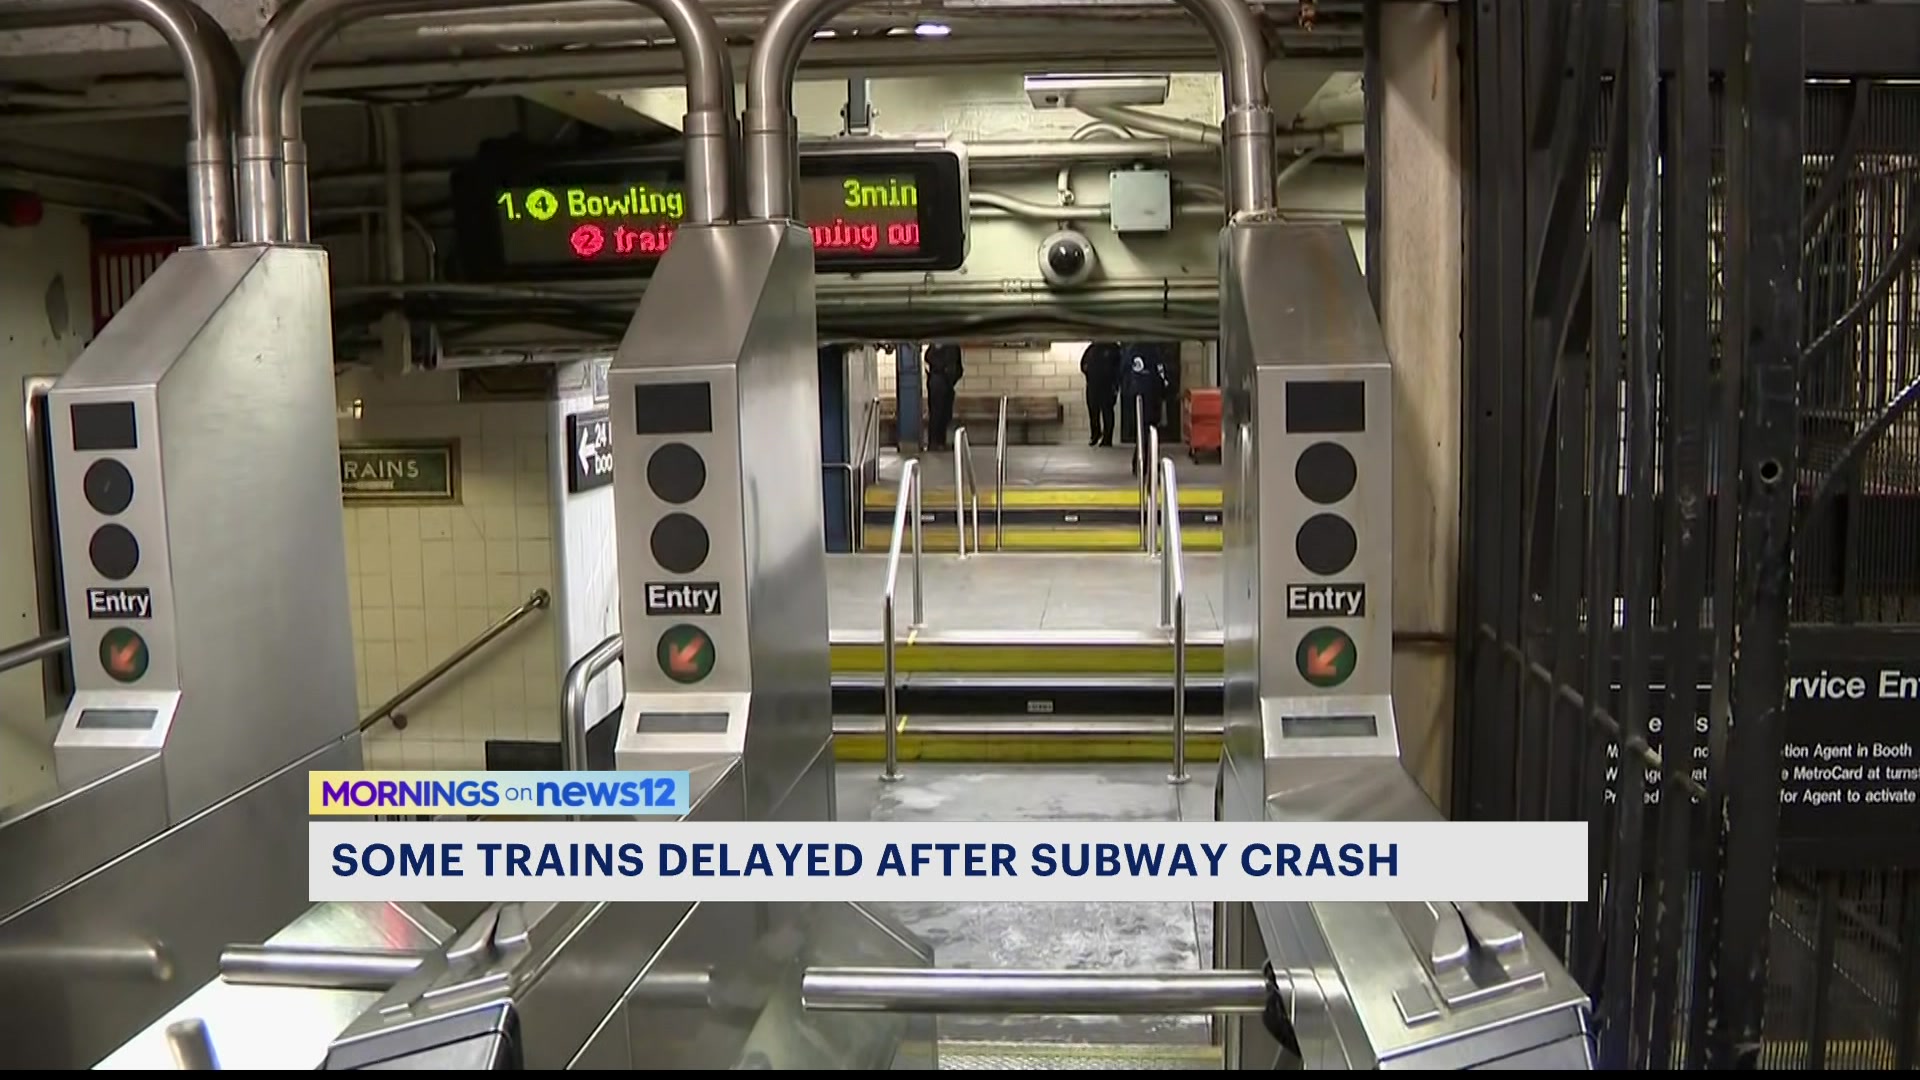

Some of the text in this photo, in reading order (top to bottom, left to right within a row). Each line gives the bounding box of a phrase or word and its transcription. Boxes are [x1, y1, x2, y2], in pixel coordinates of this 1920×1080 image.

[567, 186, 684, 218] Bowling
[844, 178, 917, 207] 3min
[808, 218, 878, 250] ning
[594, 422, 607, 448] 24
[344, 460, 419, 479] RAINS
[594, 451, 613, 476] boo
[90, 591, 150, 616] Entry
[648, 584, 718, 613] Entry
[1289, 586, 1362, 615] Entry
[1789, 670, 1866, 699] rvice
[1784, 742, 1913, 761] tion Agent in Booth
[1793, 765, 1863, 781] MetroCard
[1867, 766, 1881, 780] at
[1802, 788, 1842, 806] Agent
[1846, 788, 1861, 803] to
[1864, 787, 1917, 803] activate
